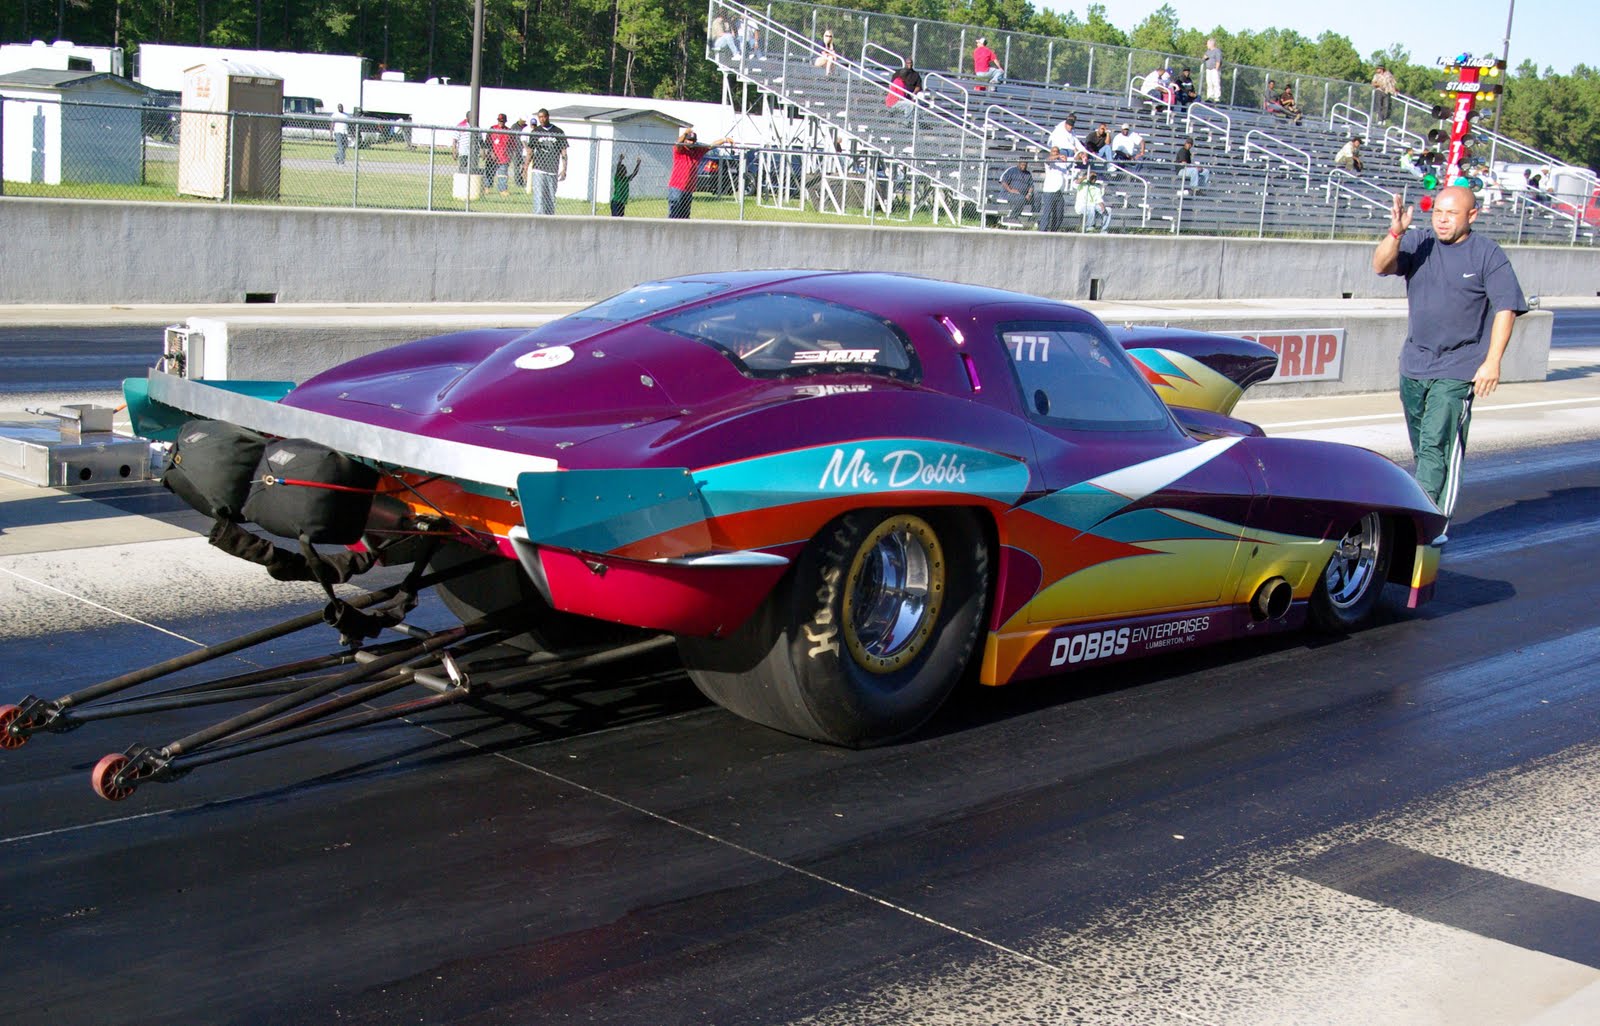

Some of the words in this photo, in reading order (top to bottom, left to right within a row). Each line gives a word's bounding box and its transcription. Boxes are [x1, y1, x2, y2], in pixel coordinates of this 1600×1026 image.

[1446, 82, 1480, 92] STAGED
[1011, 335, 1050, 362] 777
[1241, 334, 1337, 377] TRIP
[818, 448, 878, 490] Mr.
[883, 450, 966, 488] Dobbs
[1050, 627, 1130, 667] DOBBS
[1131, 616, 1210, 643] ENTERPRISES
[1145, 638, 1184, 650] LUMBERTON,
[1186, 634, 1196, 643] NC
